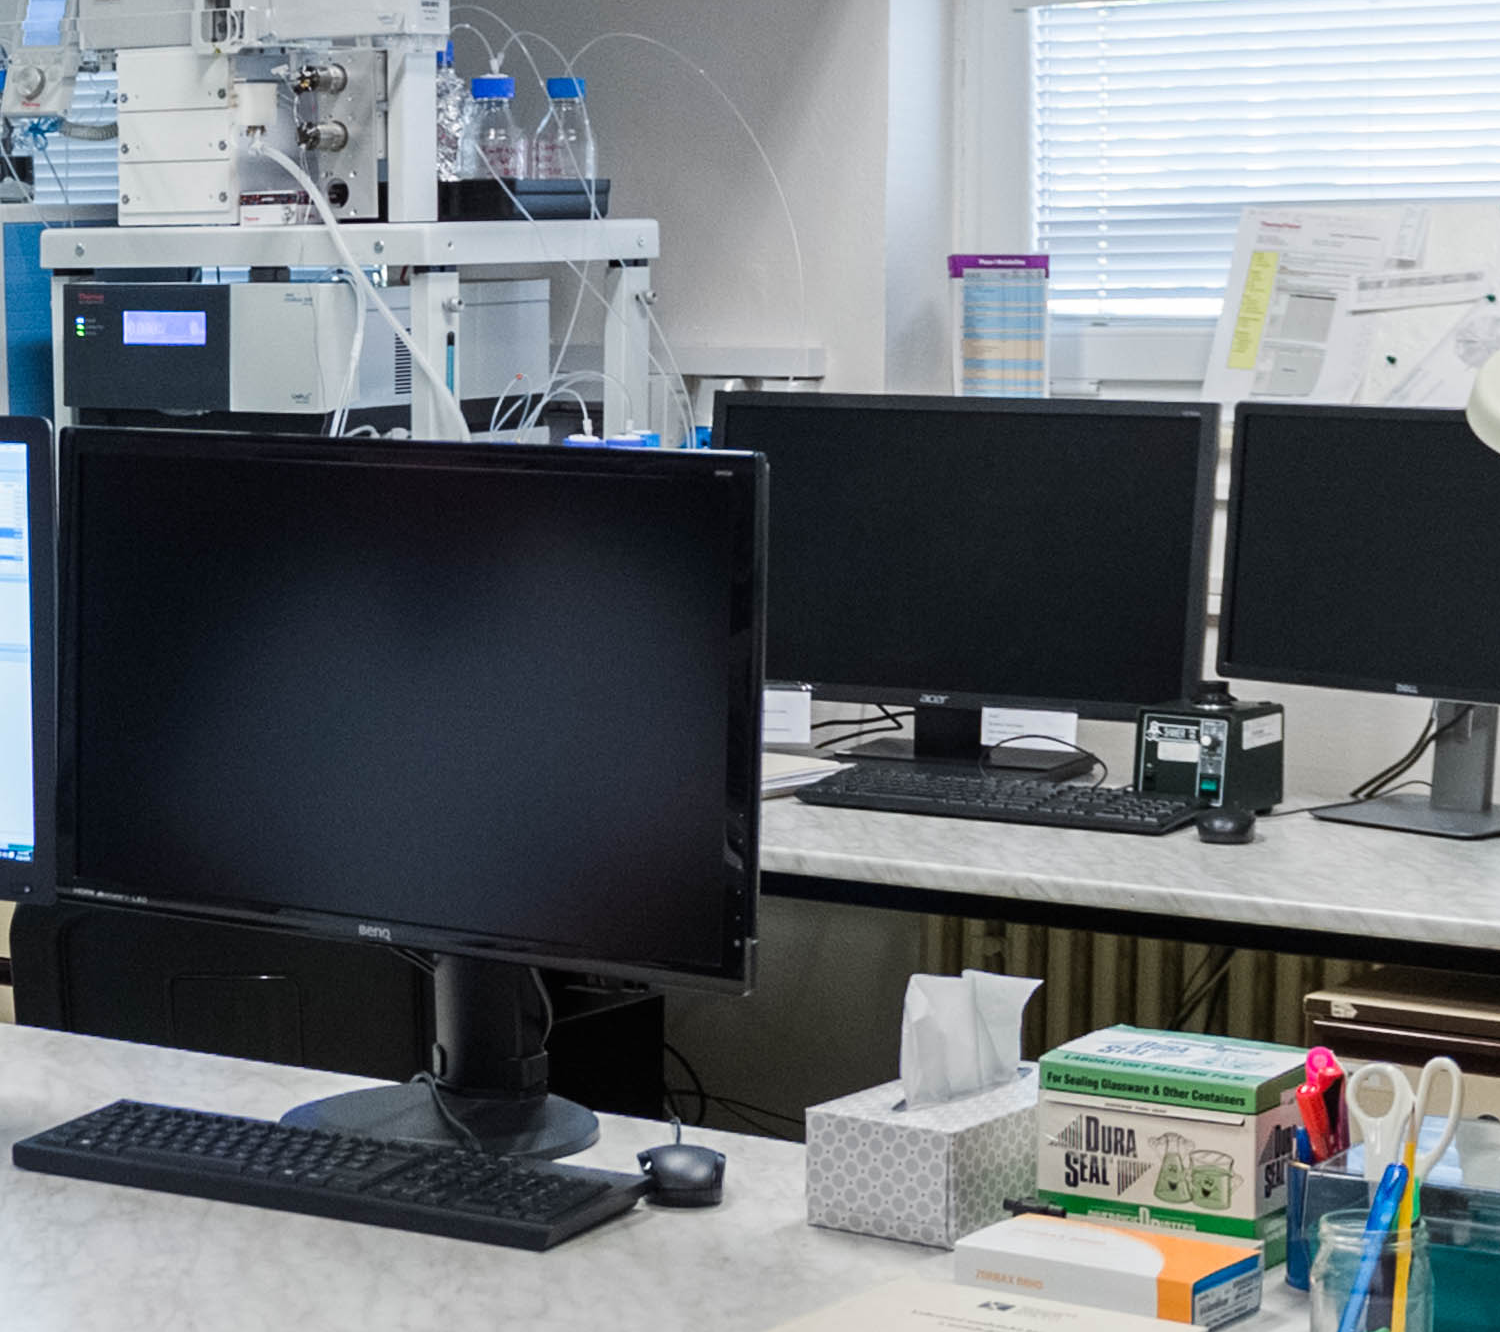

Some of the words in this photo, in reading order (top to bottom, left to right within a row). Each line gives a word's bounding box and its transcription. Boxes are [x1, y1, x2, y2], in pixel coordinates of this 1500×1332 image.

[919, 693, 950, 704] acer
[358, 924, 392, 942] BenQ
[1047, 1071, 1062, 1085] For
[1063, 1072, 1100, 1090] Sealing
[1101, 1076, 1150, 1096] Glassware
[1152, 1084, 1161, 1097] &
[1162, 1085, 1189, 1100] Other
[1191, 1089, 1247, 1107] Containers
[1084, 1115, 1138, 1158] DURA
[1064, 1151, 1111, 1189] SEAL
